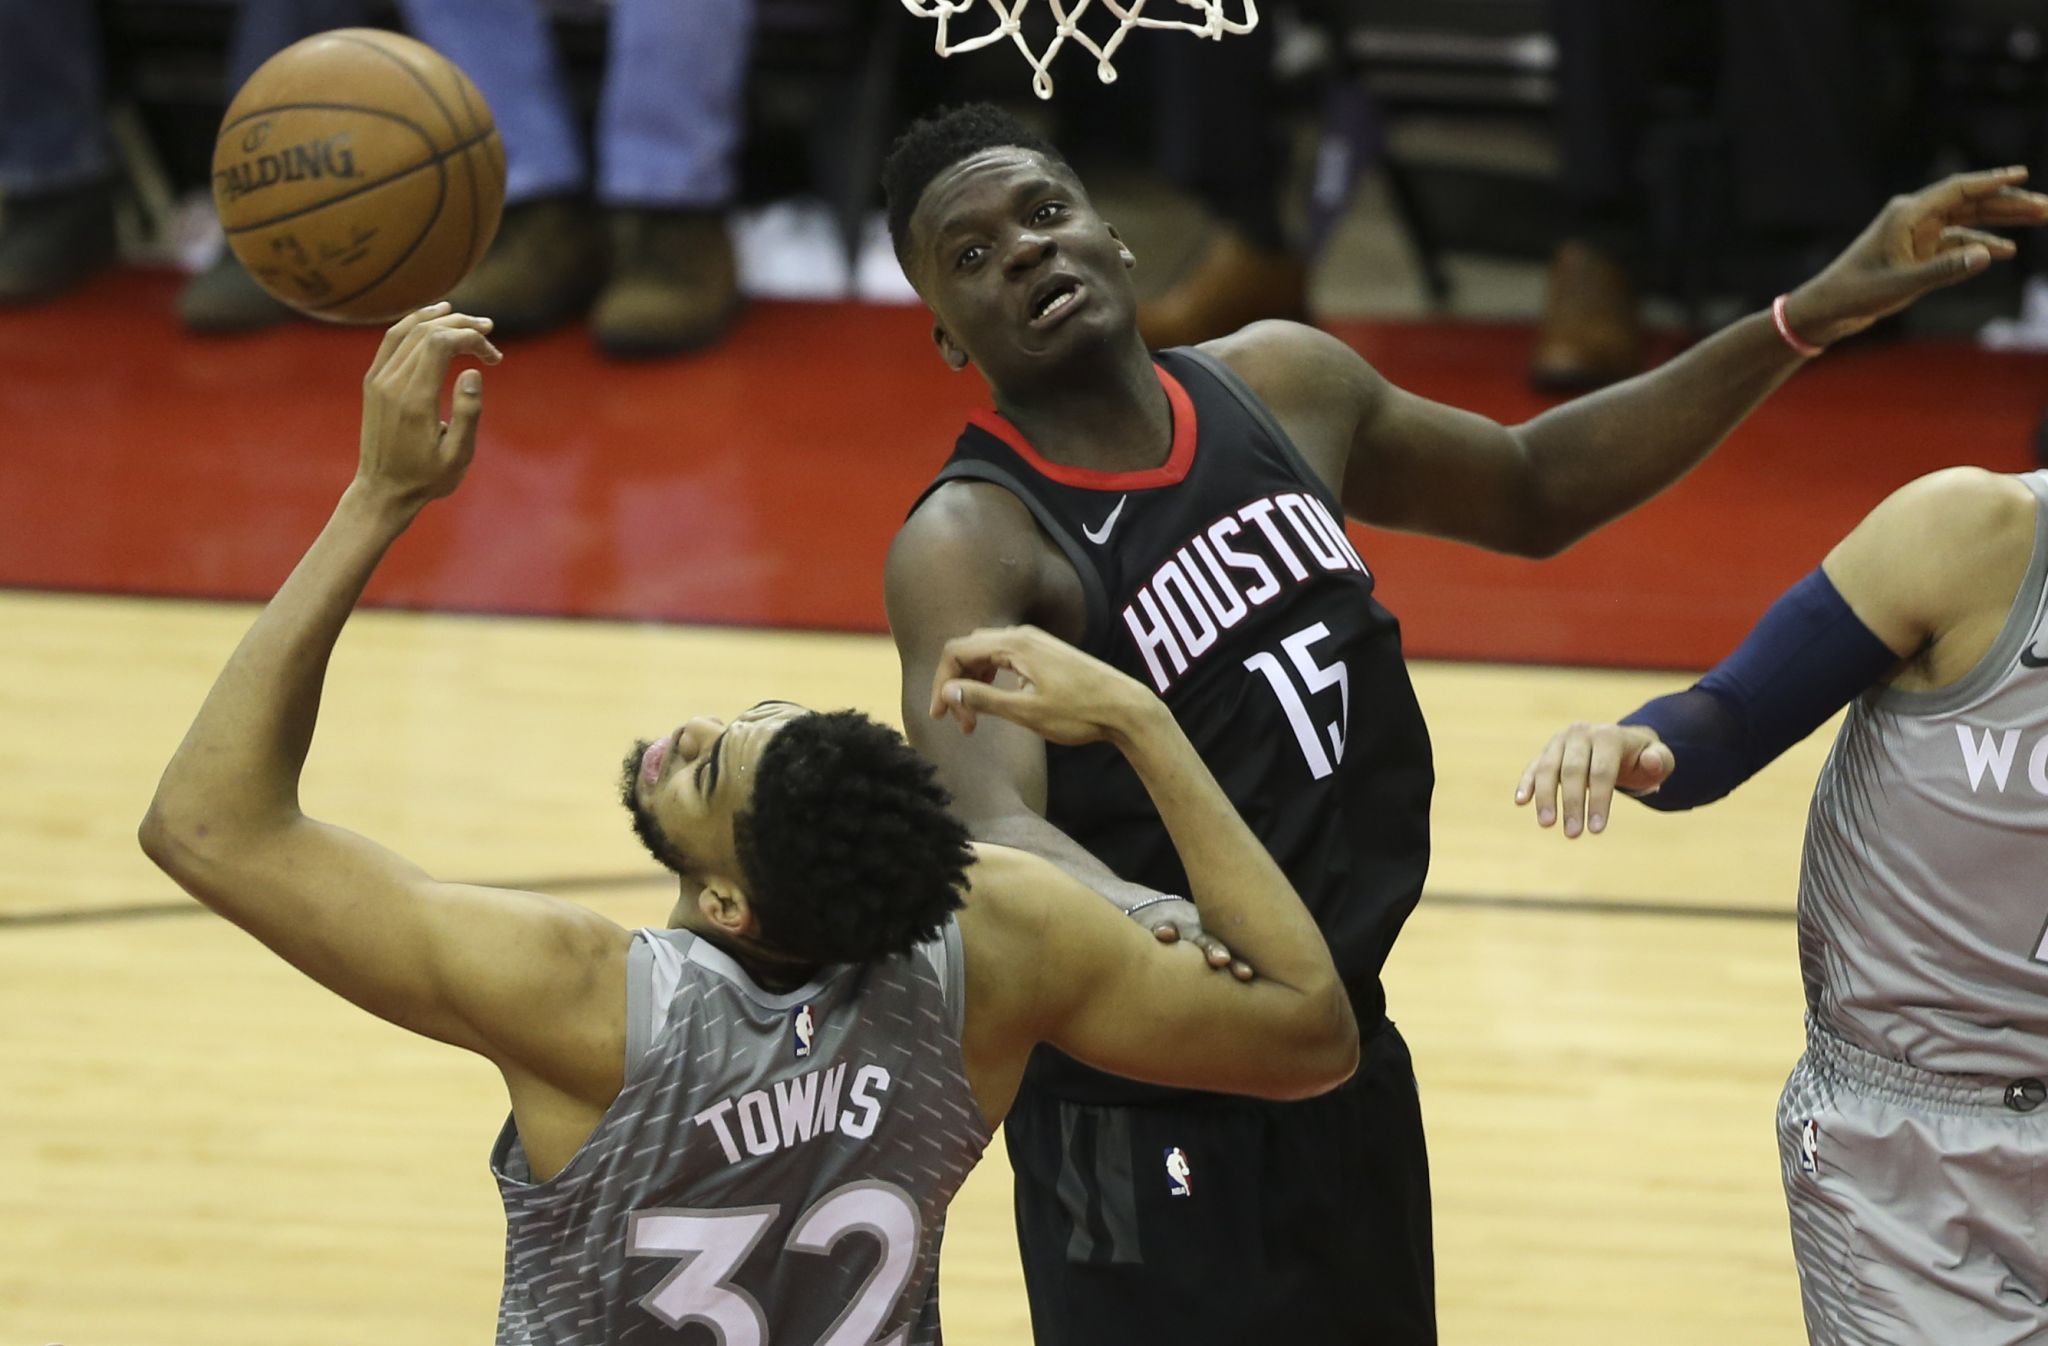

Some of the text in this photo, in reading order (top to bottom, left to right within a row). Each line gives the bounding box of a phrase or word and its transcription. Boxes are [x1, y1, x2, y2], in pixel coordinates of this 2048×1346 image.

[1122, 493, 1370, 694] HOUSTON
[1242, 621, 1350, 780] 15
[694, 1062, 890, 1164] TOWNS
[625, 1179, 921, 1346] 32
